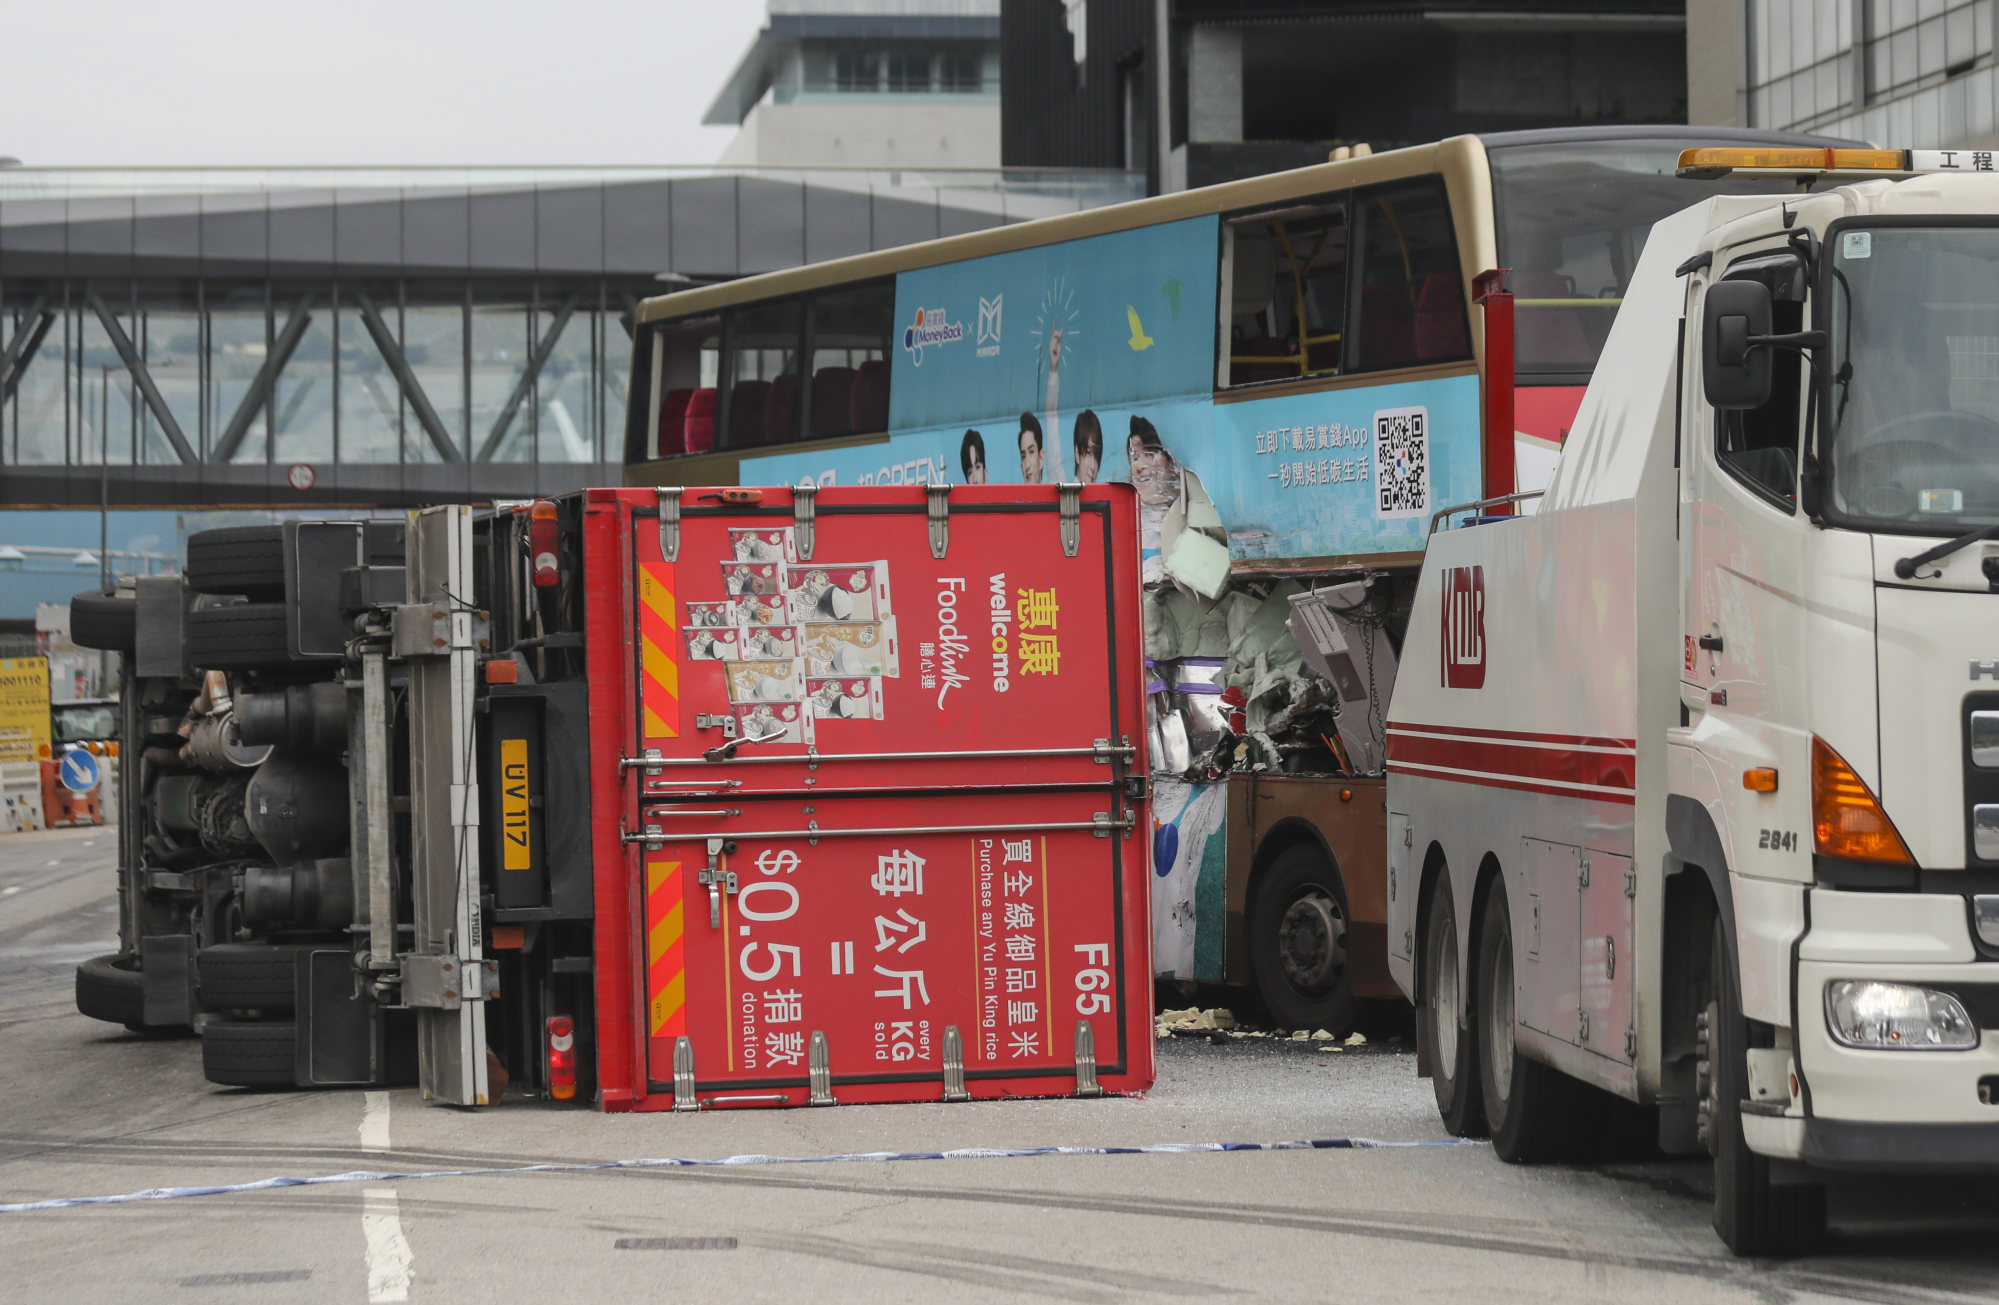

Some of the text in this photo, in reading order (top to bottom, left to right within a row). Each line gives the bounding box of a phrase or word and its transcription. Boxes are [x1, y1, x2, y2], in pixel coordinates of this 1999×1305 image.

[937, 577, 970, 710] Foodlink
[989, 572, 1011, 693] wellcome
[1017, 587, 1061, 676] 惠康
[1440, 565, 1486, 690] KMB
[505, 763, 527, 848] UV 117
[1759, 828, 1798, 853] 2841
[738, 849, 802, 982] $0.5
[870, 848, 931, 1010] 每公斤
[979, 839, 999, 1060] Purchase any Yu Pin King rice
[1001, 838, 1040, 1059] 買全線御品皇米
[1073, 942, 1111, 1016] F65
[742, 992, 758, 1070] donation
[763, 988, 805, 1069] 捐款
[874, 1022, 888, 1060] sold
[888, 1021, 915, 1062] KG
[917, 1019, 931, 1061] every
